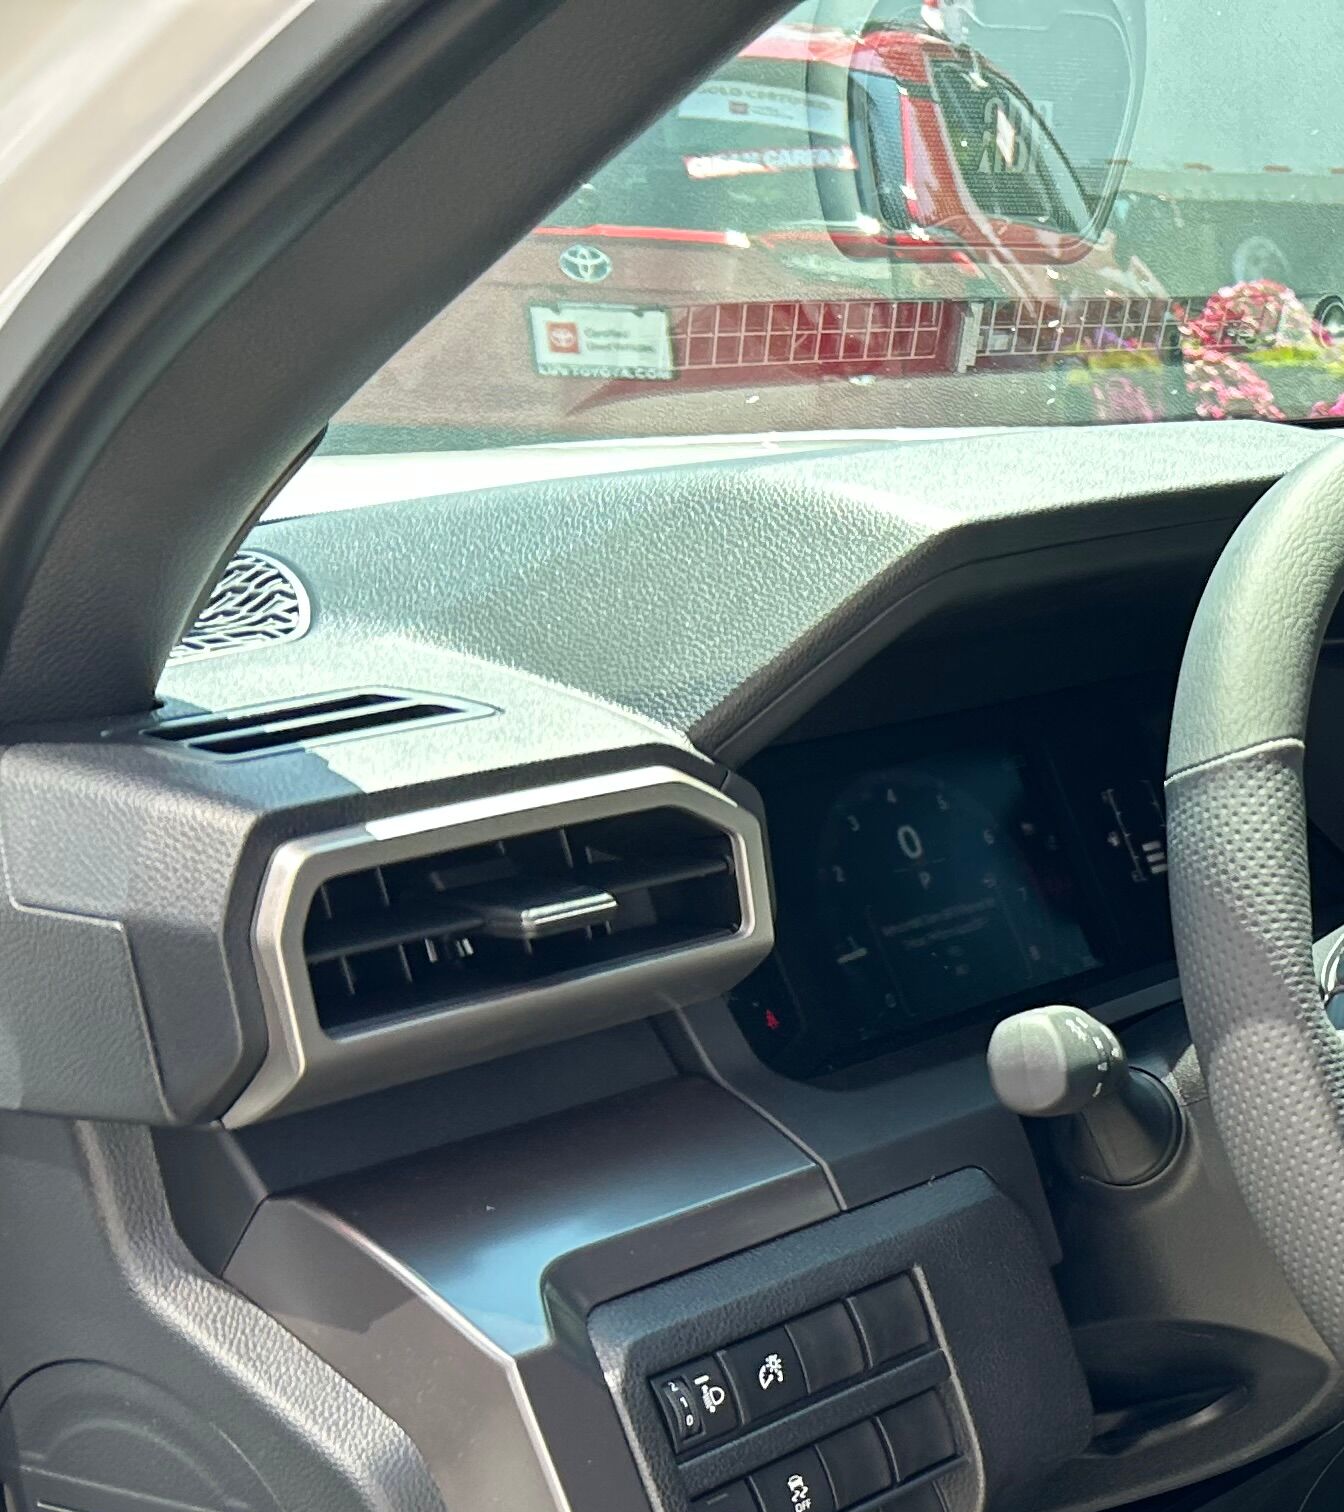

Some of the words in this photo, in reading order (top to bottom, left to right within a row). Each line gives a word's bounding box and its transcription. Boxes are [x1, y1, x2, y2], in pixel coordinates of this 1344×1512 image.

[896, 824, 923, 860] 0
[667, 1380, 679, 1392] 2
[679, 1395, 689, 1409] 1
[685, 1413, 695, 1427] 0
